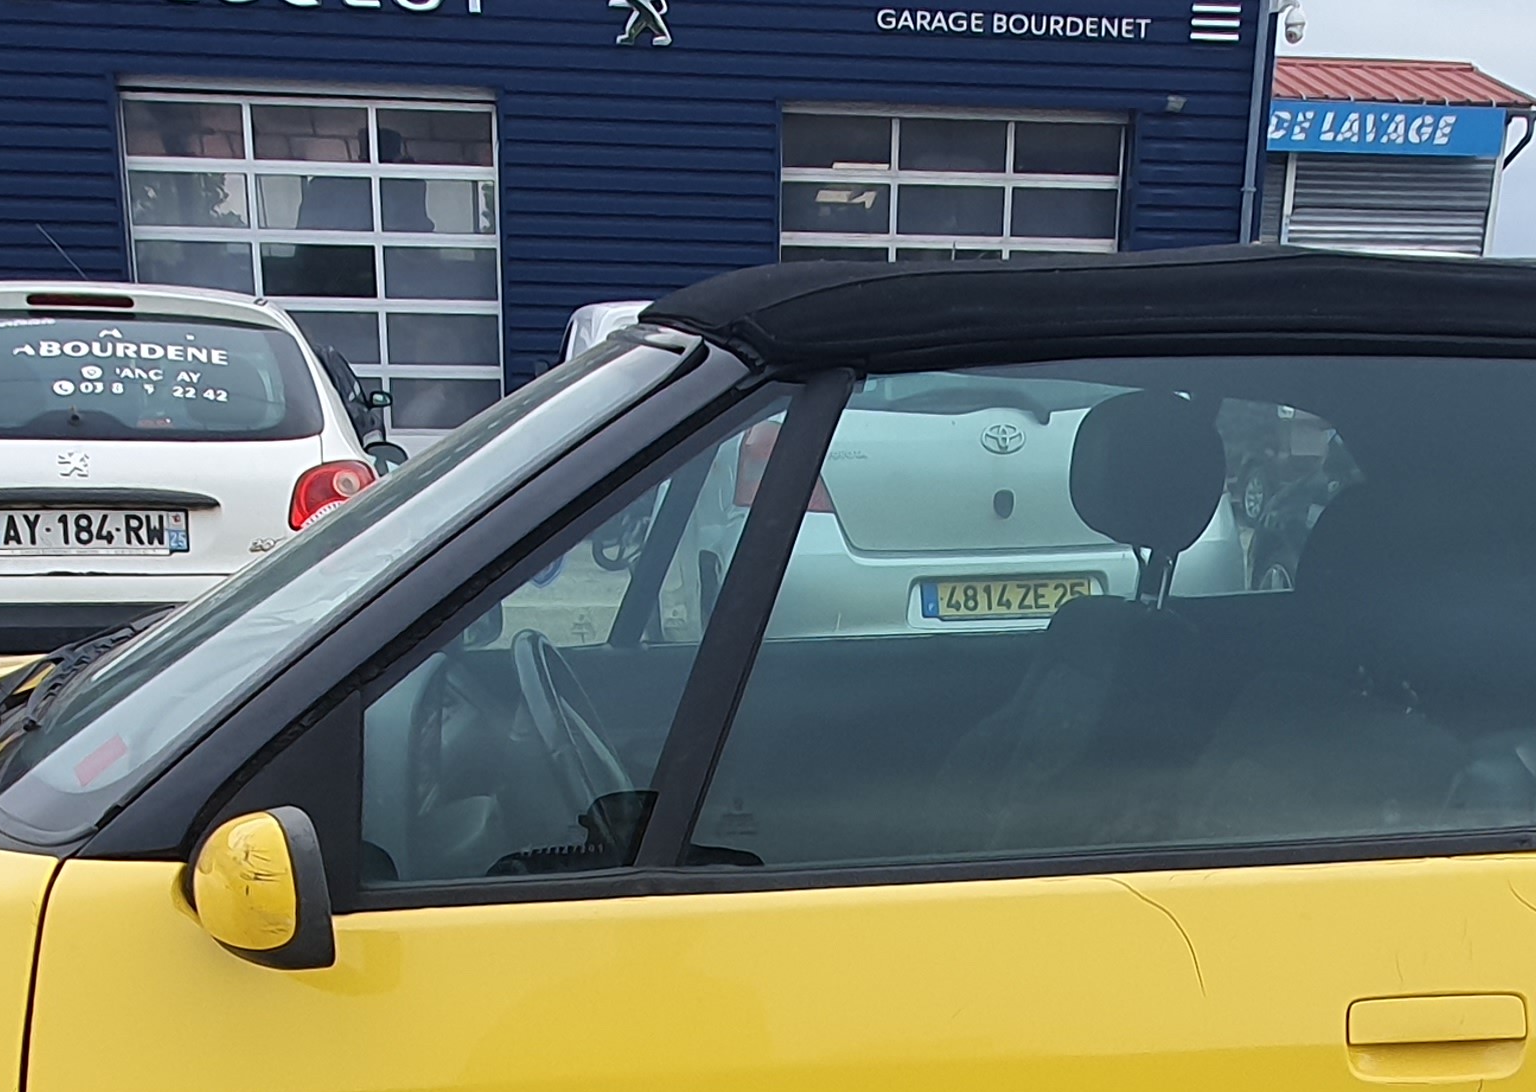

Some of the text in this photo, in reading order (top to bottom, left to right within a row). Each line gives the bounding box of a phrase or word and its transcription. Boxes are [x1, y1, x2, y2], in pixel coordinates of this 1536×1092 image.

[877, 9, 1152, 39] GARAGE BOURDENET
[1267, 110, 1457, 145] DE LAVAGE
[172, 385, 197, 399] 22
[202, 388, 229, 402] 42
[3, 513, 165, 546] AY-184-RW
[946, 583, 1013, 612] 4814
[1017, 583, 1050, 611] ZE
